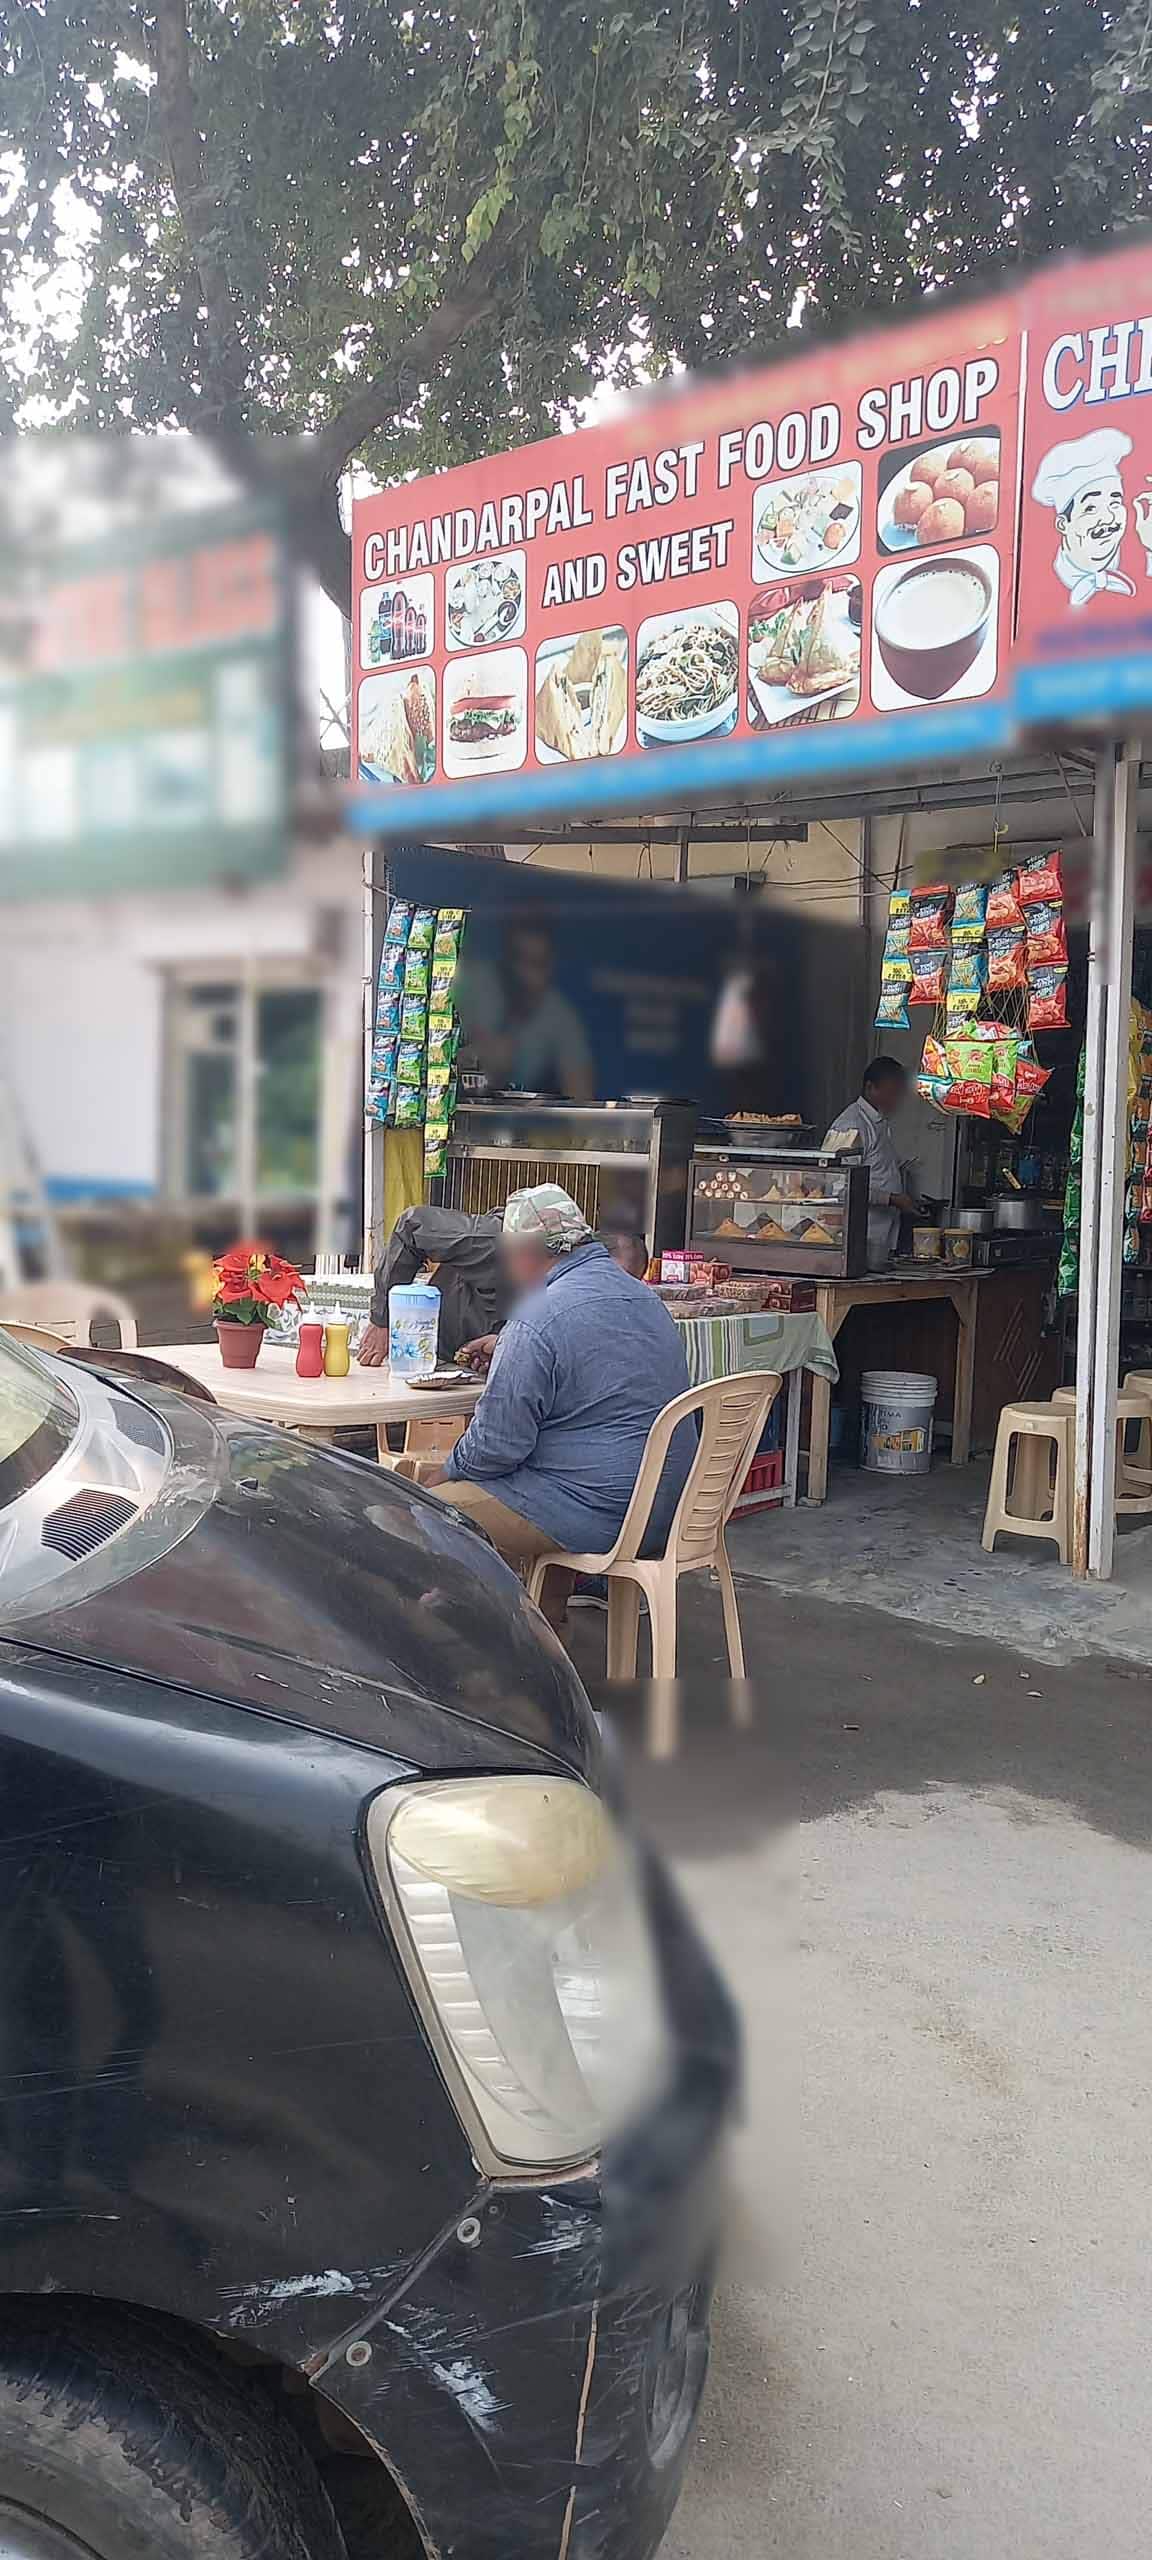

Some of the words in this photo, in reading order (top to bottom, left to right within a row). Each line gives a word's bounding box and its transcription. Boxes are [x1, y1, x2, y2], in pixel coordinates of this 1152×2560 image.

[363, 475, 593, 581] CHANDARPAL
[605, 441, 704, 519] FAST
[718, 402, 840, 489] FOOD
[856, 357, 999, 450] SHOP
[541, 553, 607, 608] AND
[616, 520, 735, 591] SWEET
